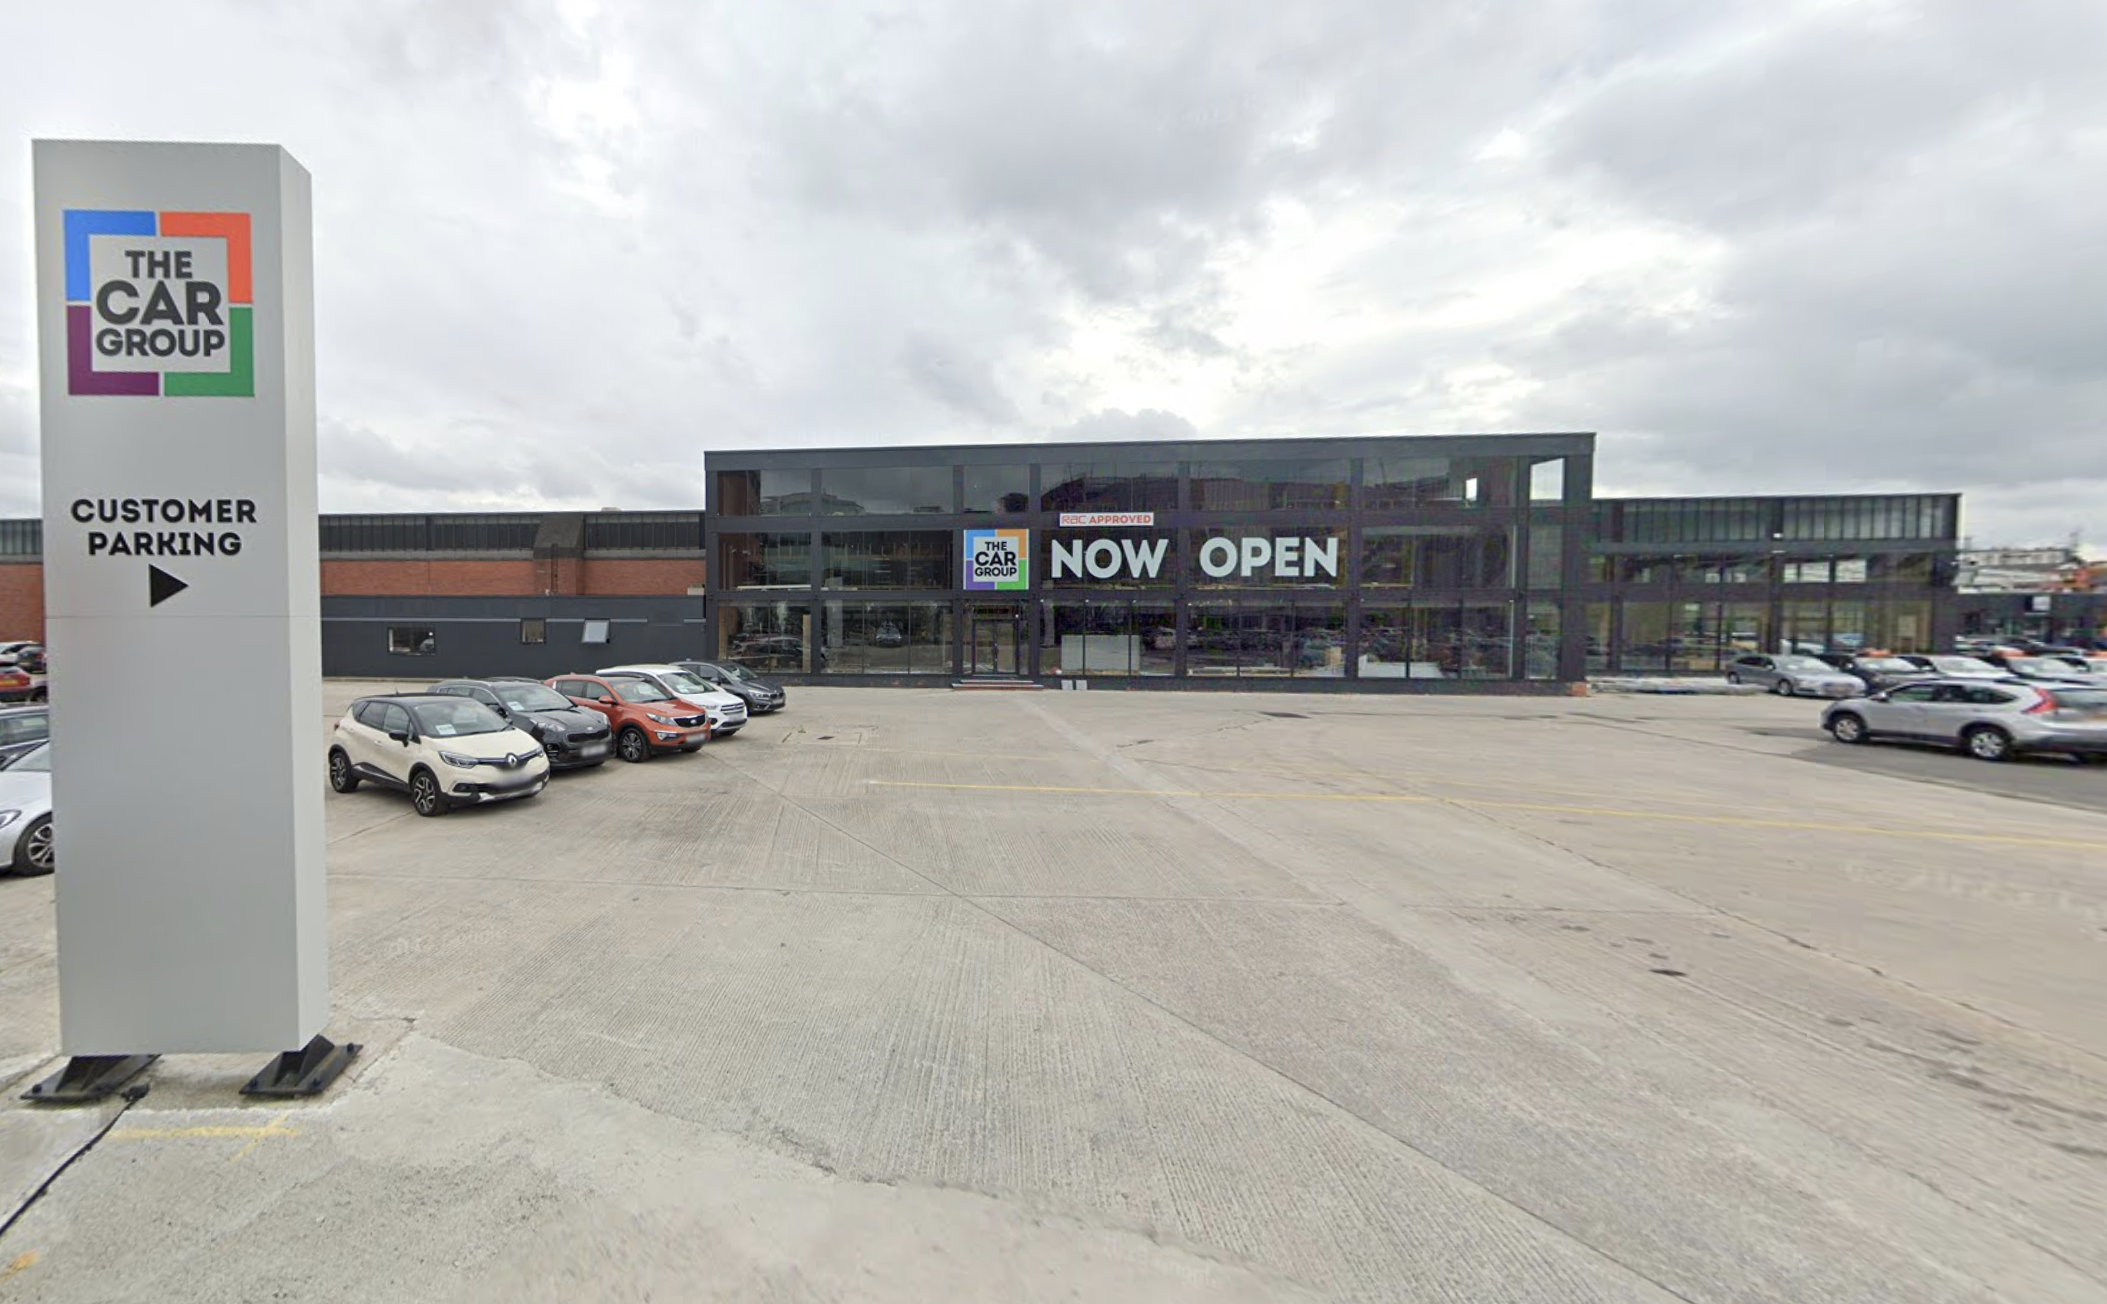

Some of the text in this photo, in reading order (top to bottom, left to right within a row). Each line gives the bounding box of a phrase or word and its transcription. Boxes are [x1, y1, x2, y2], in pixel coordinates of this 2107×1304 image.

[125, 251, 193, 278] THE
[96, 280, 224, 326] CAR
[96, 328, 225, 357] GROUP
[71, 499, 257, 524] CUSTOMER
[1089, 515, 1151, 524] APPROVED
[88, 532, 242, 556] PARKING
[985, 541, 1007, 551] THE
[975, 551, 1017, 566] CAR
[1051, 537, 1338, 579] NOW OPEN
[974, 567, 1017, 577] GROUP
